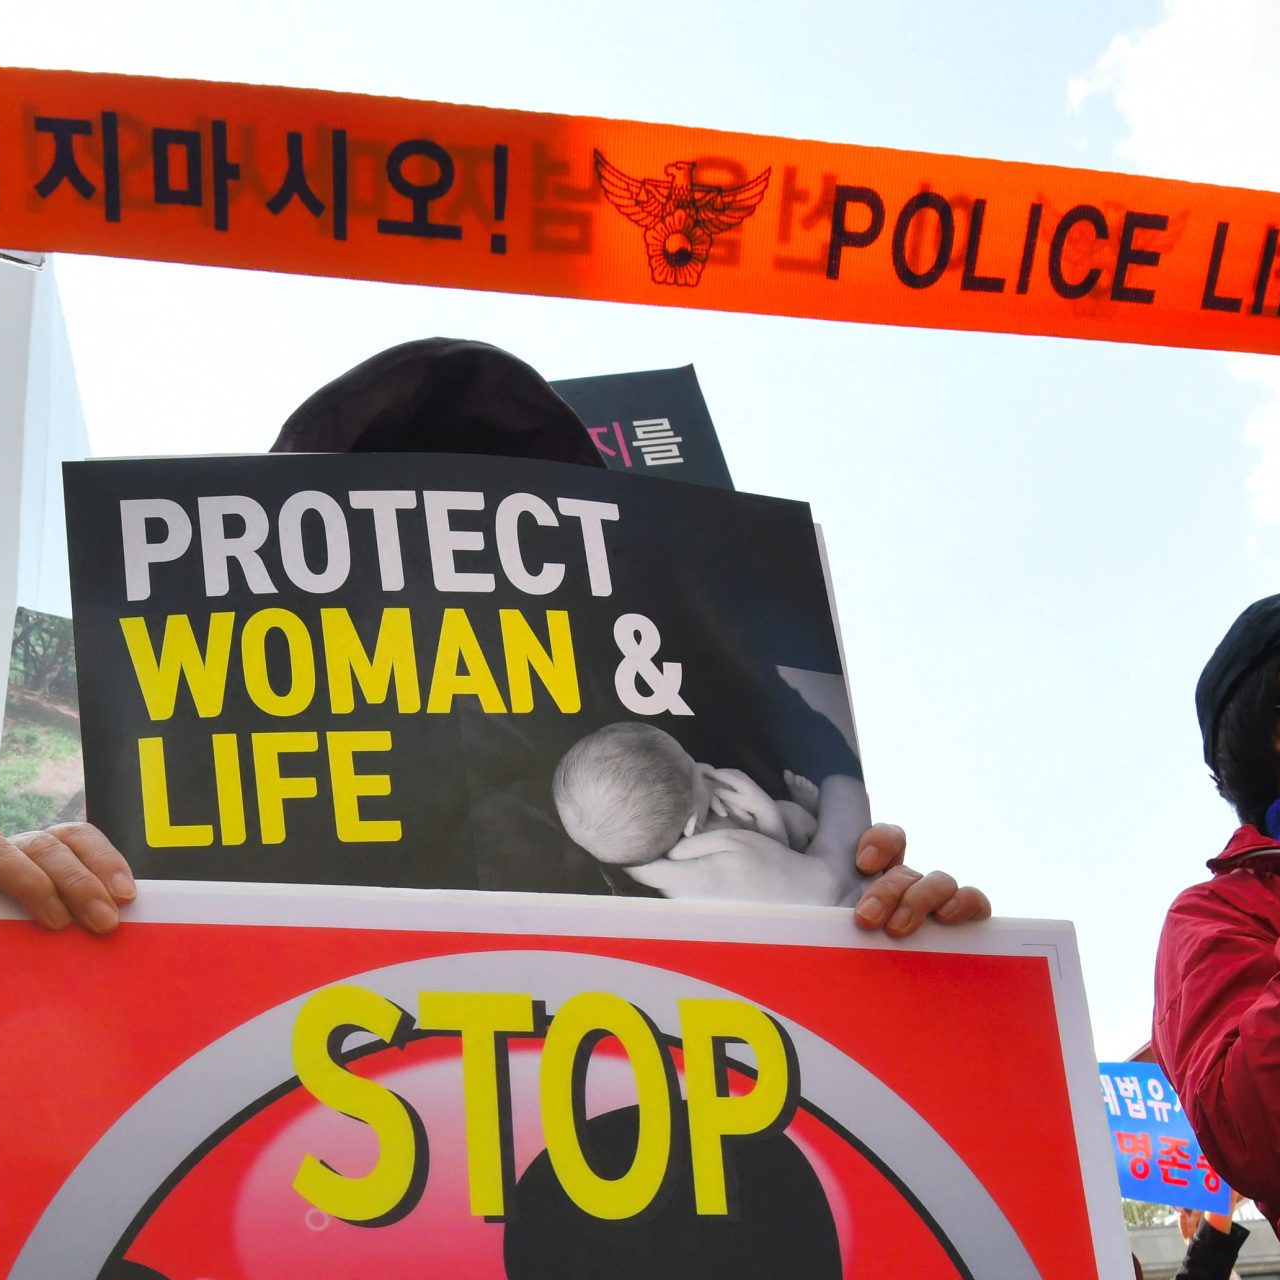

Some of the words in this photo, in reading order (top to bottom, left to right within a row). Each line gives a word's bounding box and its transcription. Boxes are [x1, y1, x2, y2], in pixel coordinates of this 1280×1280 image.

[827, 185, 1168, 304] POLICE
[120, 490, 620, 602] PROTECT
[120, 607, 582, 721] WOMAN
[613, 613, 695, 716] &
[138, 730, 403, 848] LIFE
[291, 984, 789, 1222] STOP
